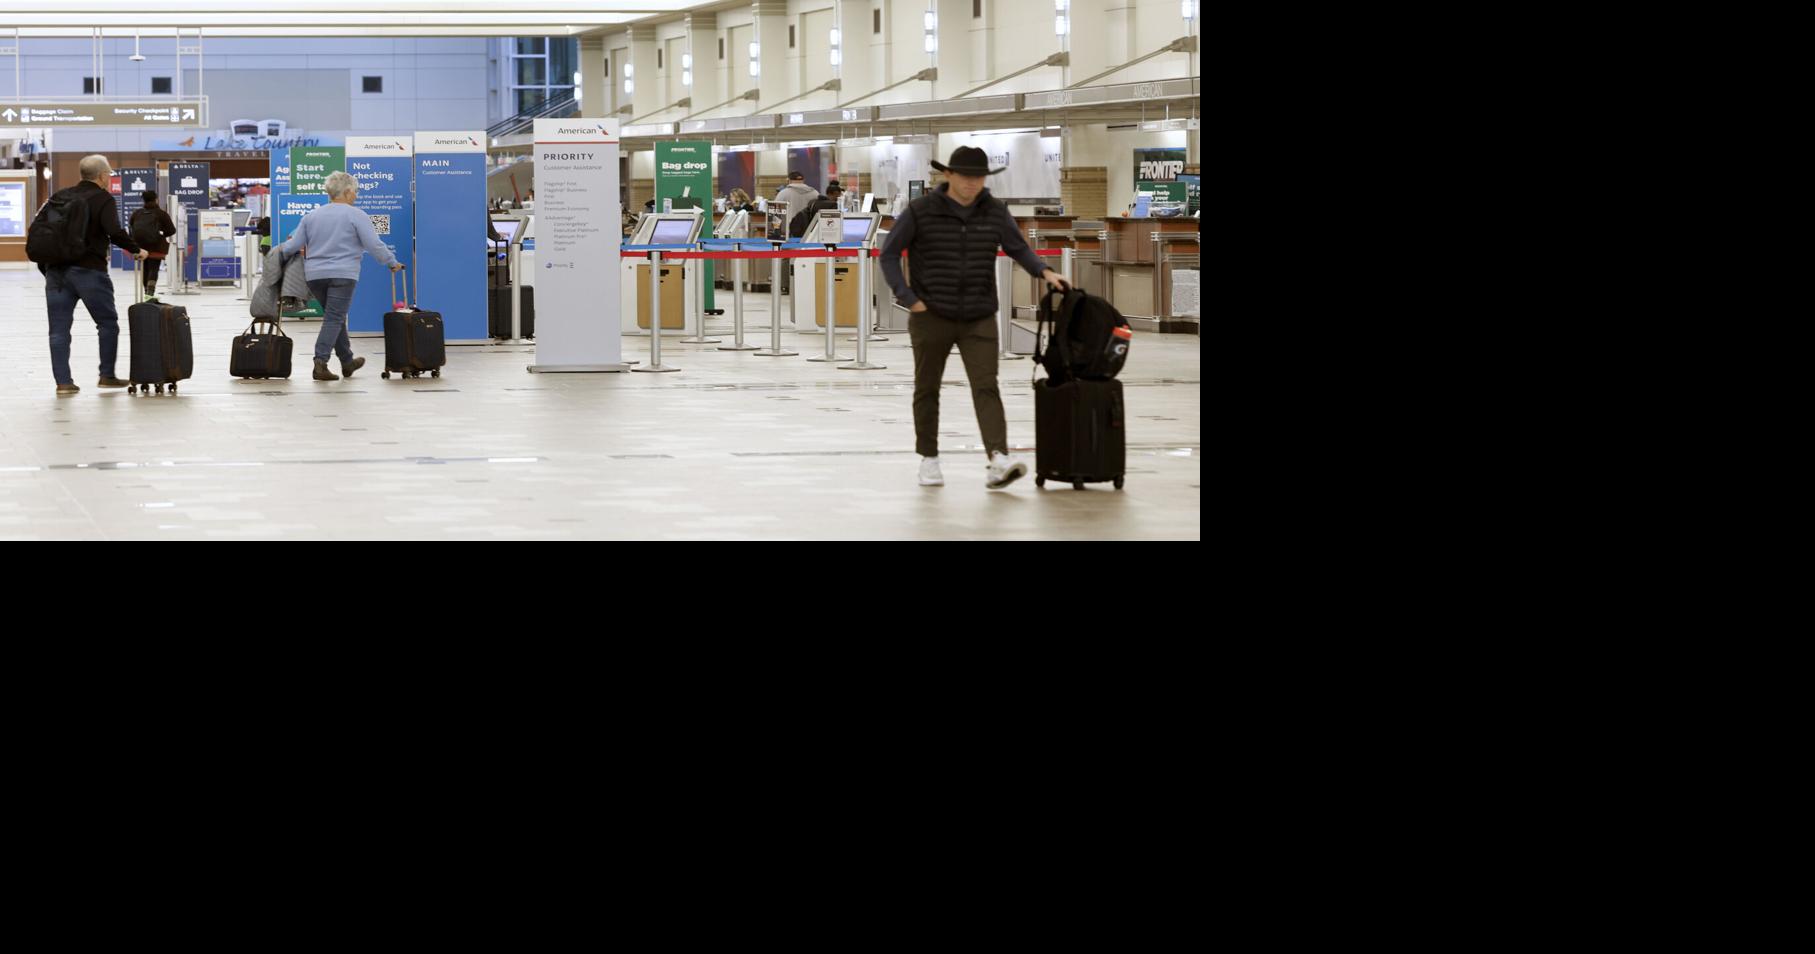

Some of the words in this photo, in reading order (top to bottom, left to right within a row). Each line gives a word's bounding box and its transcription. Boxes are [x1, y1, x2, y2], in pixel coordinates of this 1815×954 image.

[204, 136, 247, 150] Lake
[250, 136, 319, 150] Country
[353, 162, 371, 170] Not
[422, 159, 450, 167] MAIN
[662, 161, 682, 171] Bag
[683, 161, 708, 170] drop
[296, 164, 325, 172] Start
[296, 183, 315, 191] self
[358, 182, 379, 190] ags?
